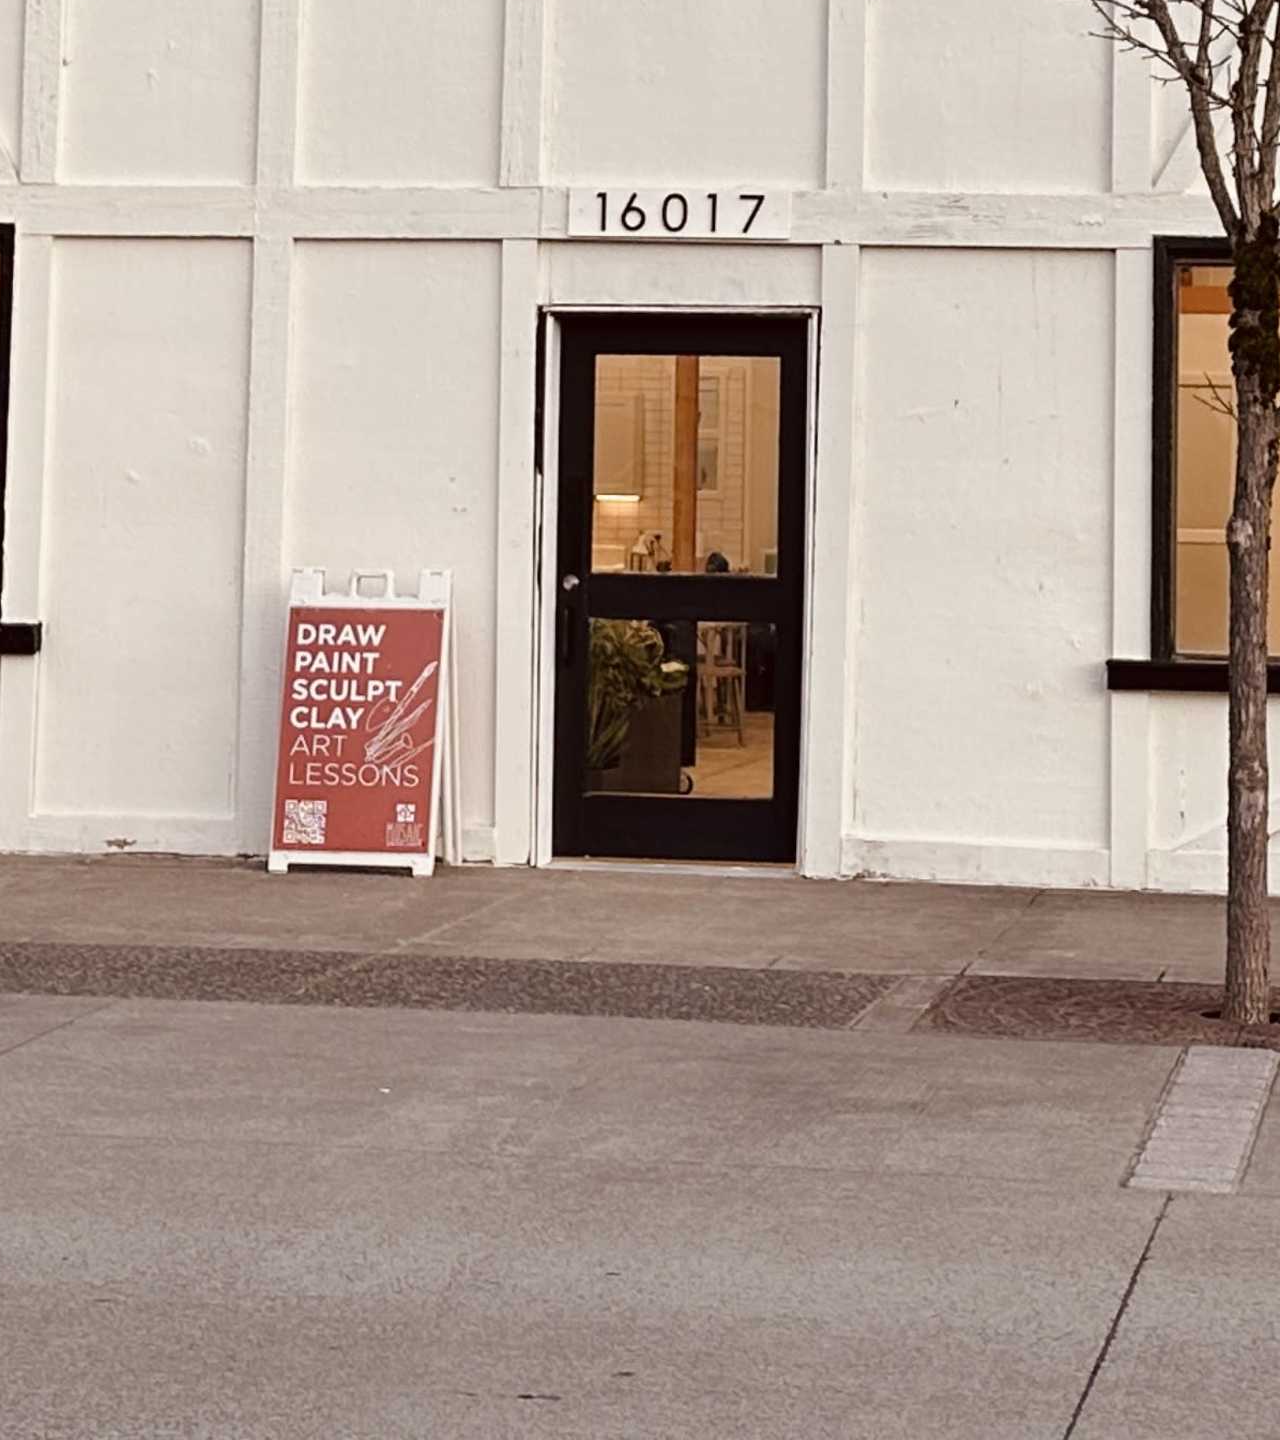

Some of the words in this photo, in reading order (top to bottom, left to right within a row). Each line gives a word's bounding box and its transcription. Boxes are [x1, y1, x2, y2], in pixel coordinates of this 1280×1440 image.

[596, 192, 765, 233] 16017
[297, 623, 387, 646] DRAW
[294, 651, 380, 674] PAINT
[291, 678, 402, 702] SCULPT
[289, 706, 365, 730] CLAY
[289, 734, 348, 757] ART
[288, 762, 420, 787] LESSONS
